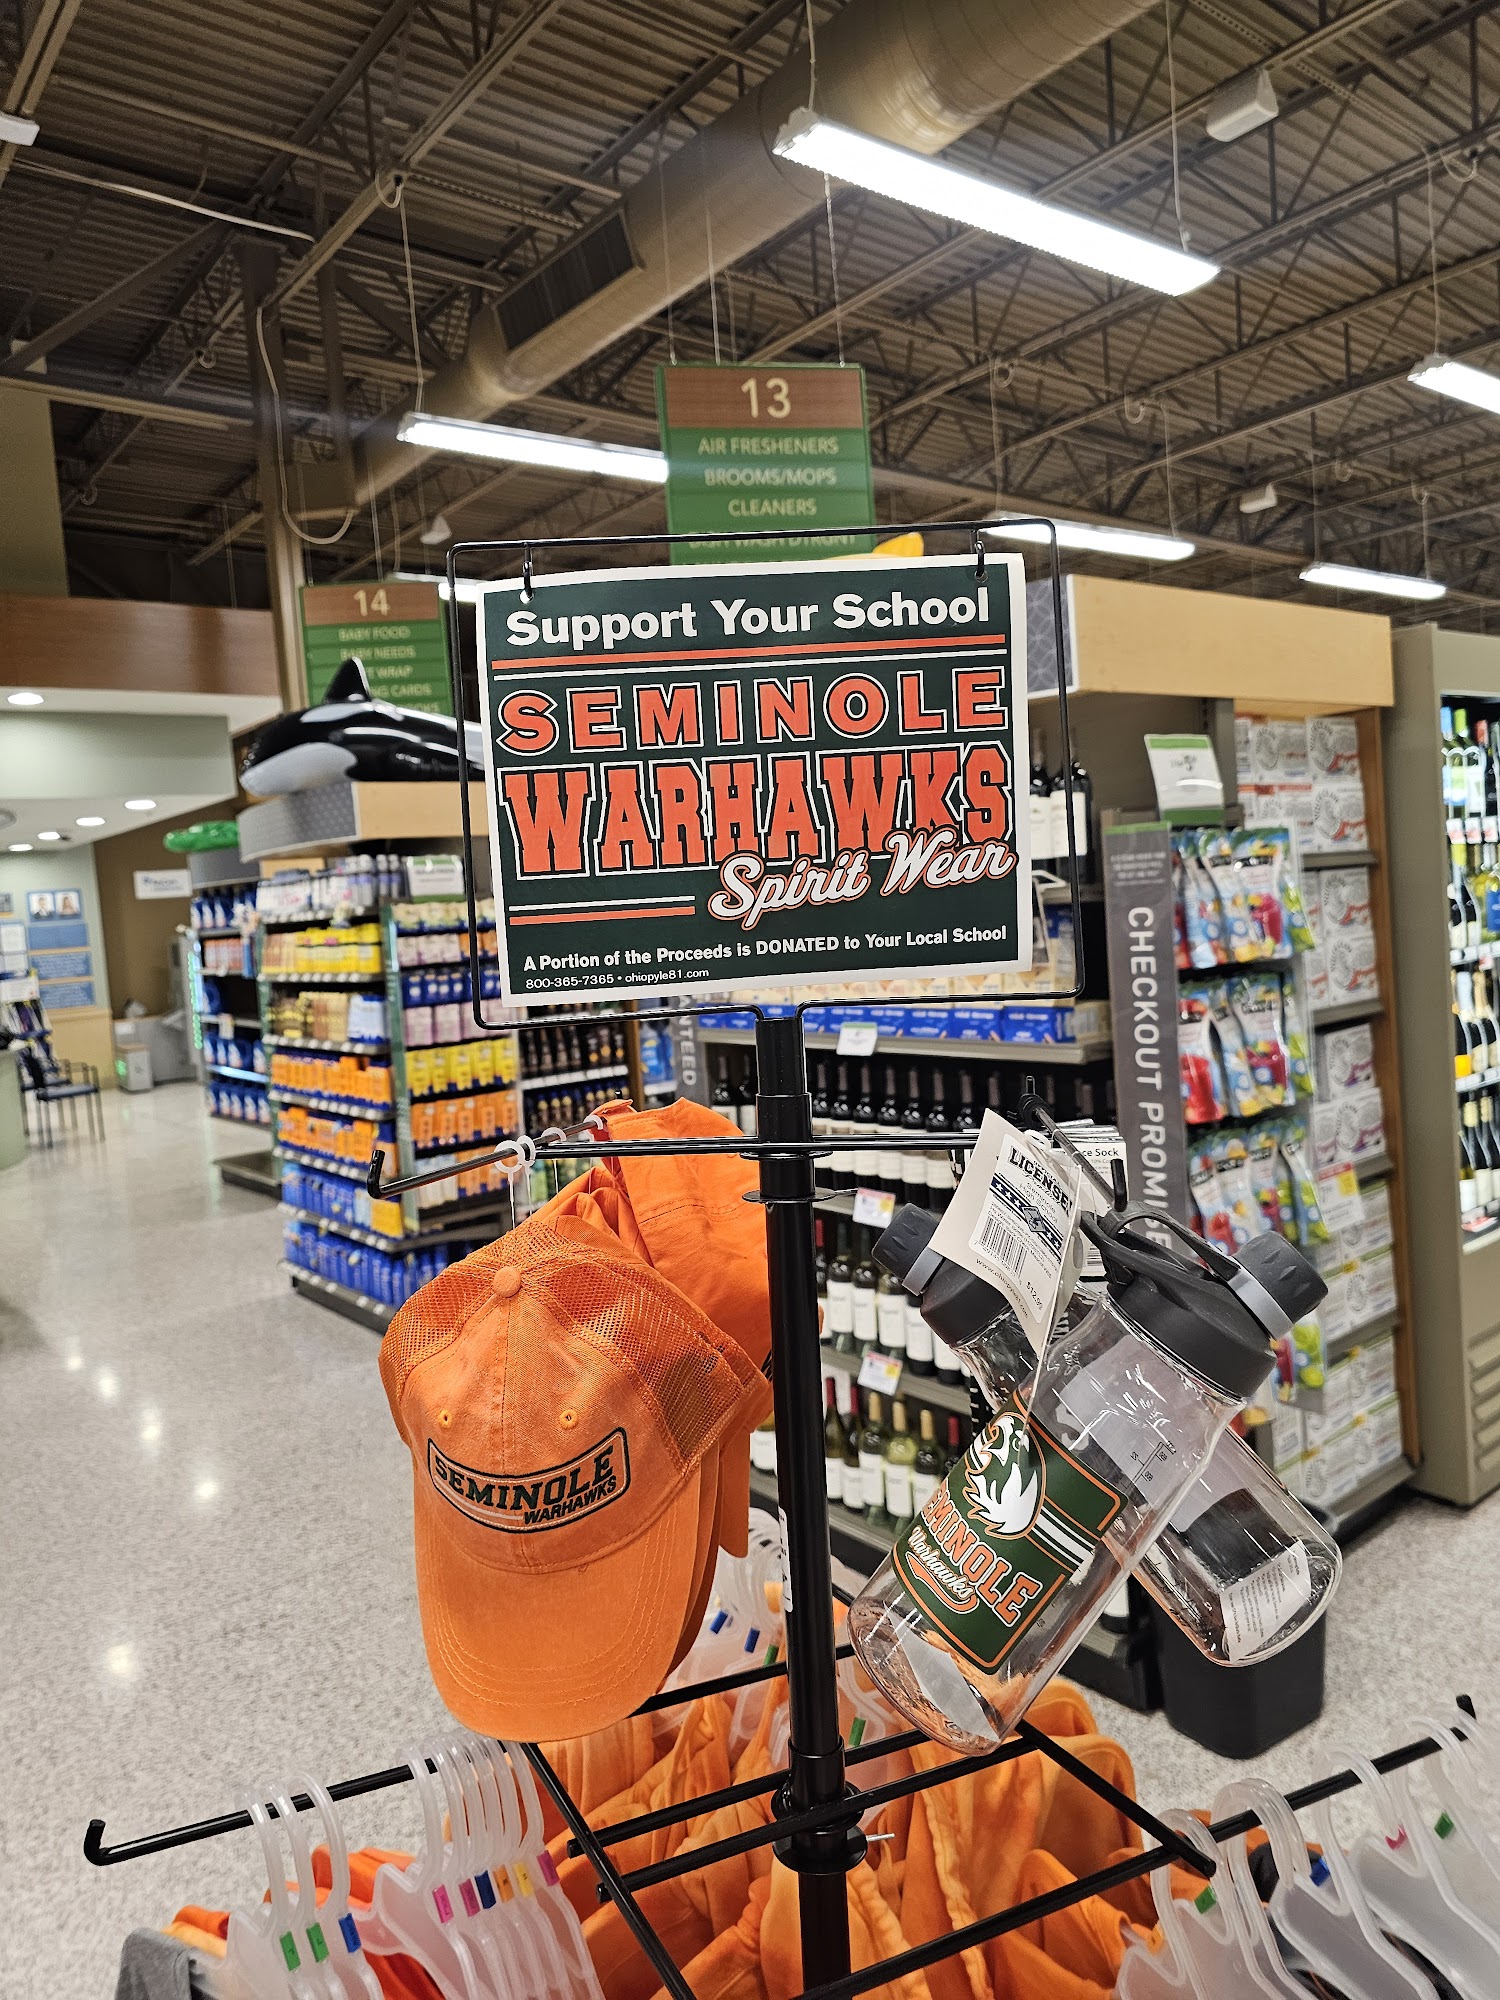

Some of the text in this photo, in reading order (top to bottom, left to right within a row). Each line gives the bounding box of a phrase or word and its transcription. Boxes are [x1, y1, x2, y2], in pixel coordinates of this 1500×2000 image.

[741, 377, 792, 419] 13
[698, 436, 839, 455] AIR FRESHENERS
[704, 467, 837, 486] BROOMS/MOPS
[728, 499, 817, 517] CLEANERS
[353, 589, 390, 616] 14
[506, 587, 989, 651] Support Your School
[338, 625, 410, 642] BABY FOOD
[374, 645, 416, 659] NEEDS
[376, 665, 413, 678] WRAP
[391, 683, 432, 697] CARDS
[496, 665, 1008, 756] SEMINOLE
[497, 741, 1013, 881] WARHAWKS
[708, 827, 1018, 930] Spirit Wear
[523, 925, 1007, 971] A Portion of the Proceeds is DONATED to Your Local School
[525, 968, 709, 989] 800-365-7365 ohiopyle81.com
[1128, 906, 1162, 1091] CHECKOUT
[679, 993, 697, 1086] ANTEED
[1095, 1147, 1119, 1157] Sock
[435, 1444, 614, 1511] SEMINOLE
[523, 1475, 617, 1525] WARHAWKS
[907, 1525, 977, 1600] Warhawks
[920, 1477, 1044, 1628] EMINOLE
